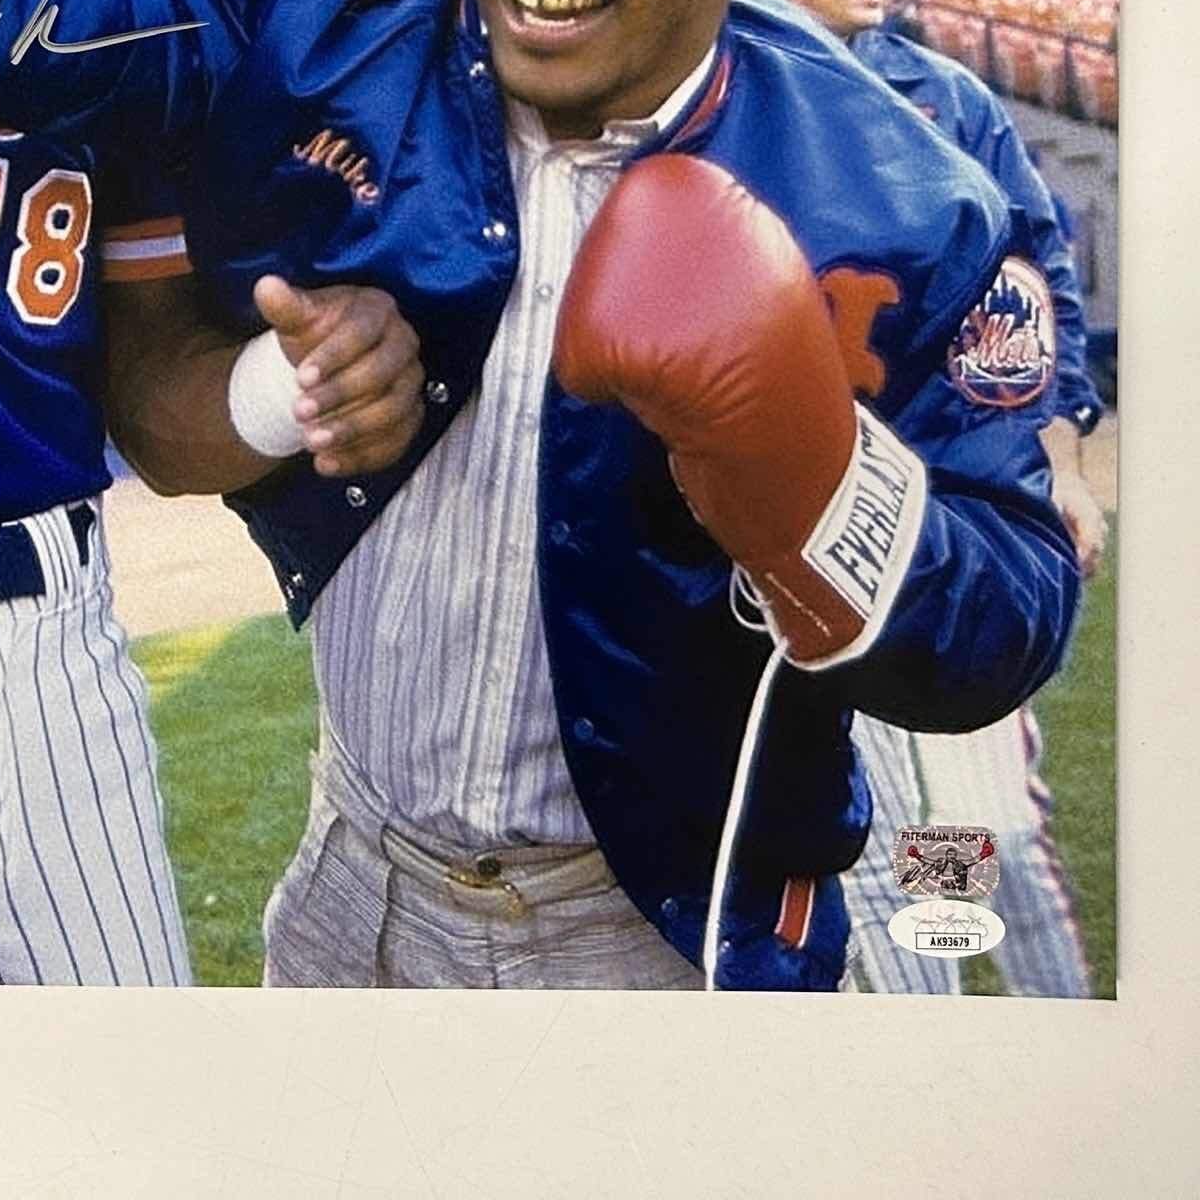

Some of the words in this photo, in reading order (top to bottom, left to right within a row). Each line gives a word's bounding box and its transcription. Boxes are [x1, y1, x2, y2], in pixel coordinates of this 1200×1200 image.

[293, 128, 380, 206] Mike
[825, 416, 913, 605] EVERLAST
[901, 831, 949, 841] FITERMAN
[952, 832, 991, 842] SPORTS
[929, 936, 970, 948] AK93679
